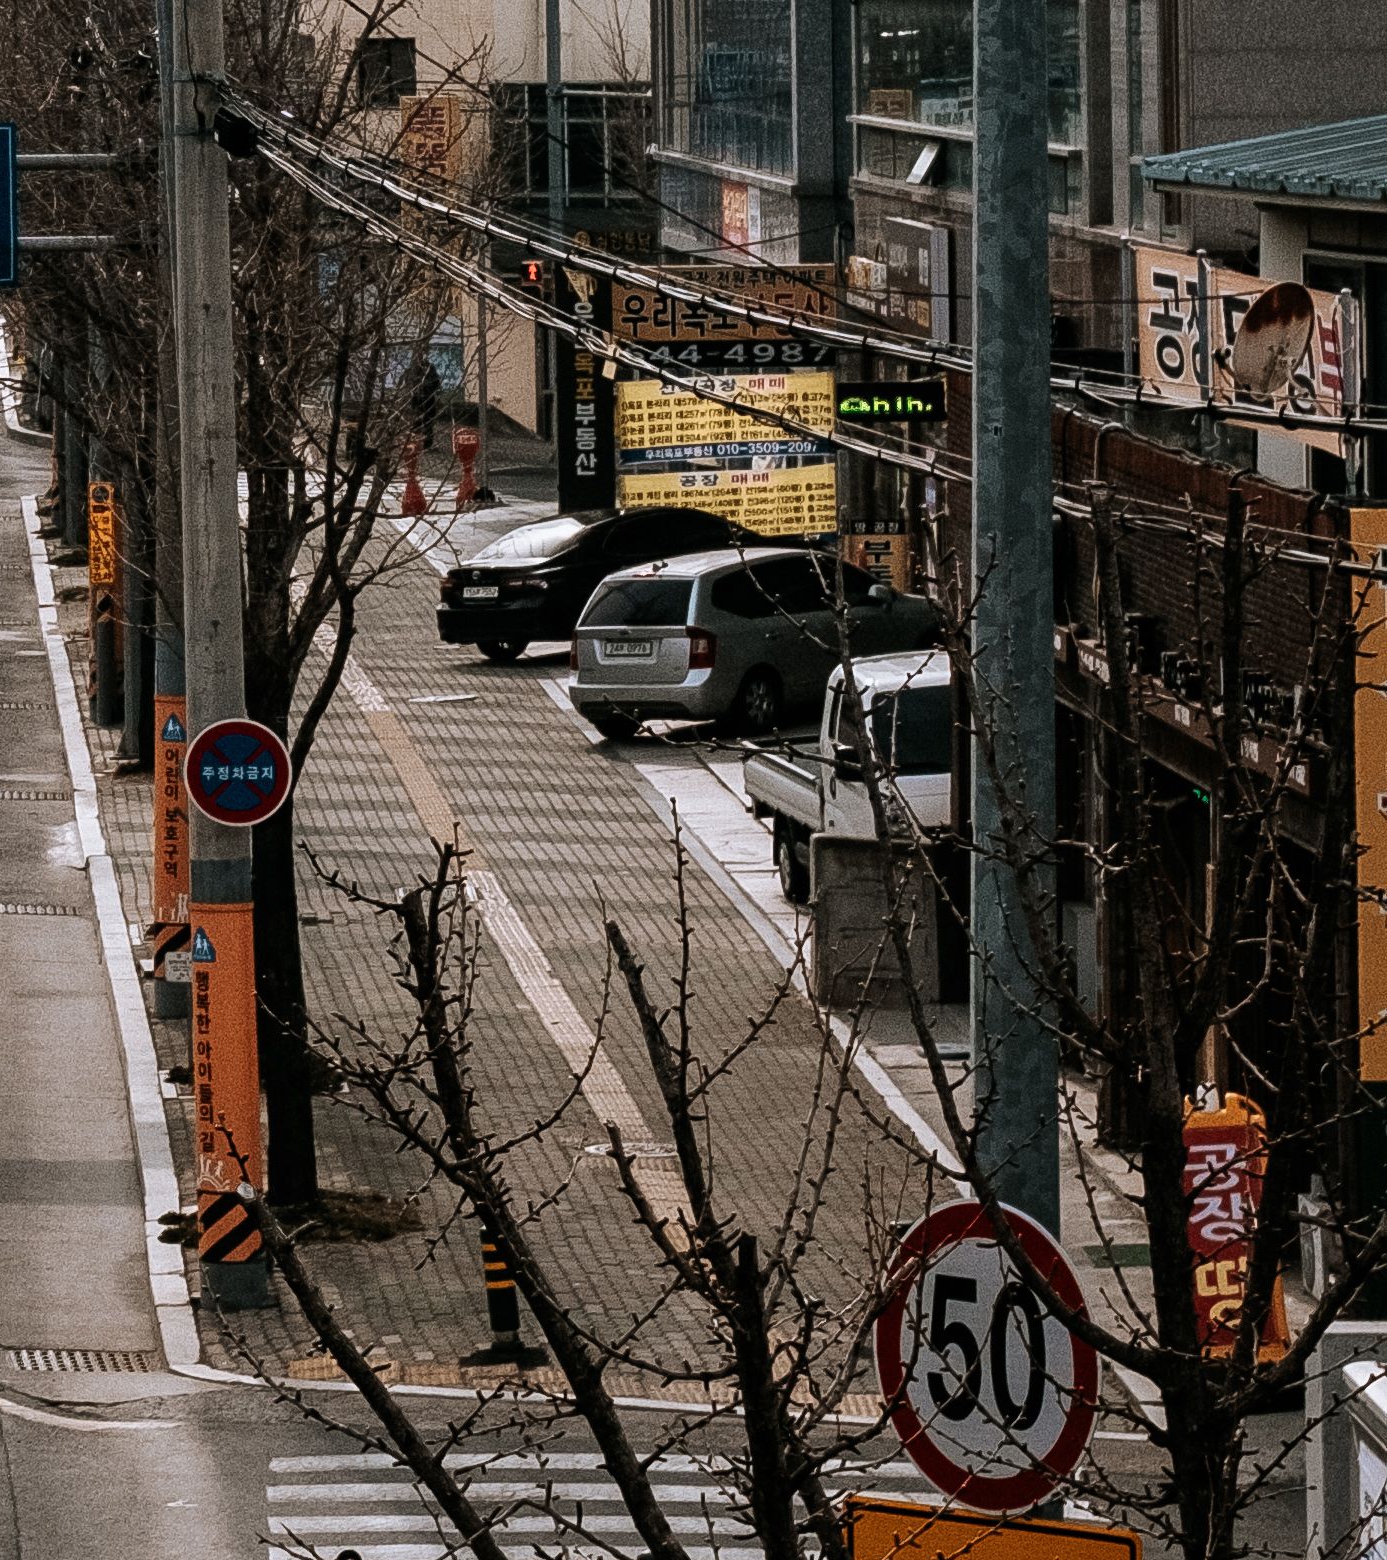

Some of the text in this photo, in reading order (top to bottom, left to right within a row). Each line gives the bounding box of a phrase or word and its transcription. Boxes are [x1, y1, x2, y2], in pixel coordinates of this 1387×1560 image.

[748, 377, 786, 390] 매매
[680, 471, 769, 487] 공장 매매
[202, 766, 274, 781] 주정차금지
[163, 806, 179, 879] 보호구역
[1184, 1143, 1248, 1242] 공장
[926, 1274, 1047, 1431] 50
